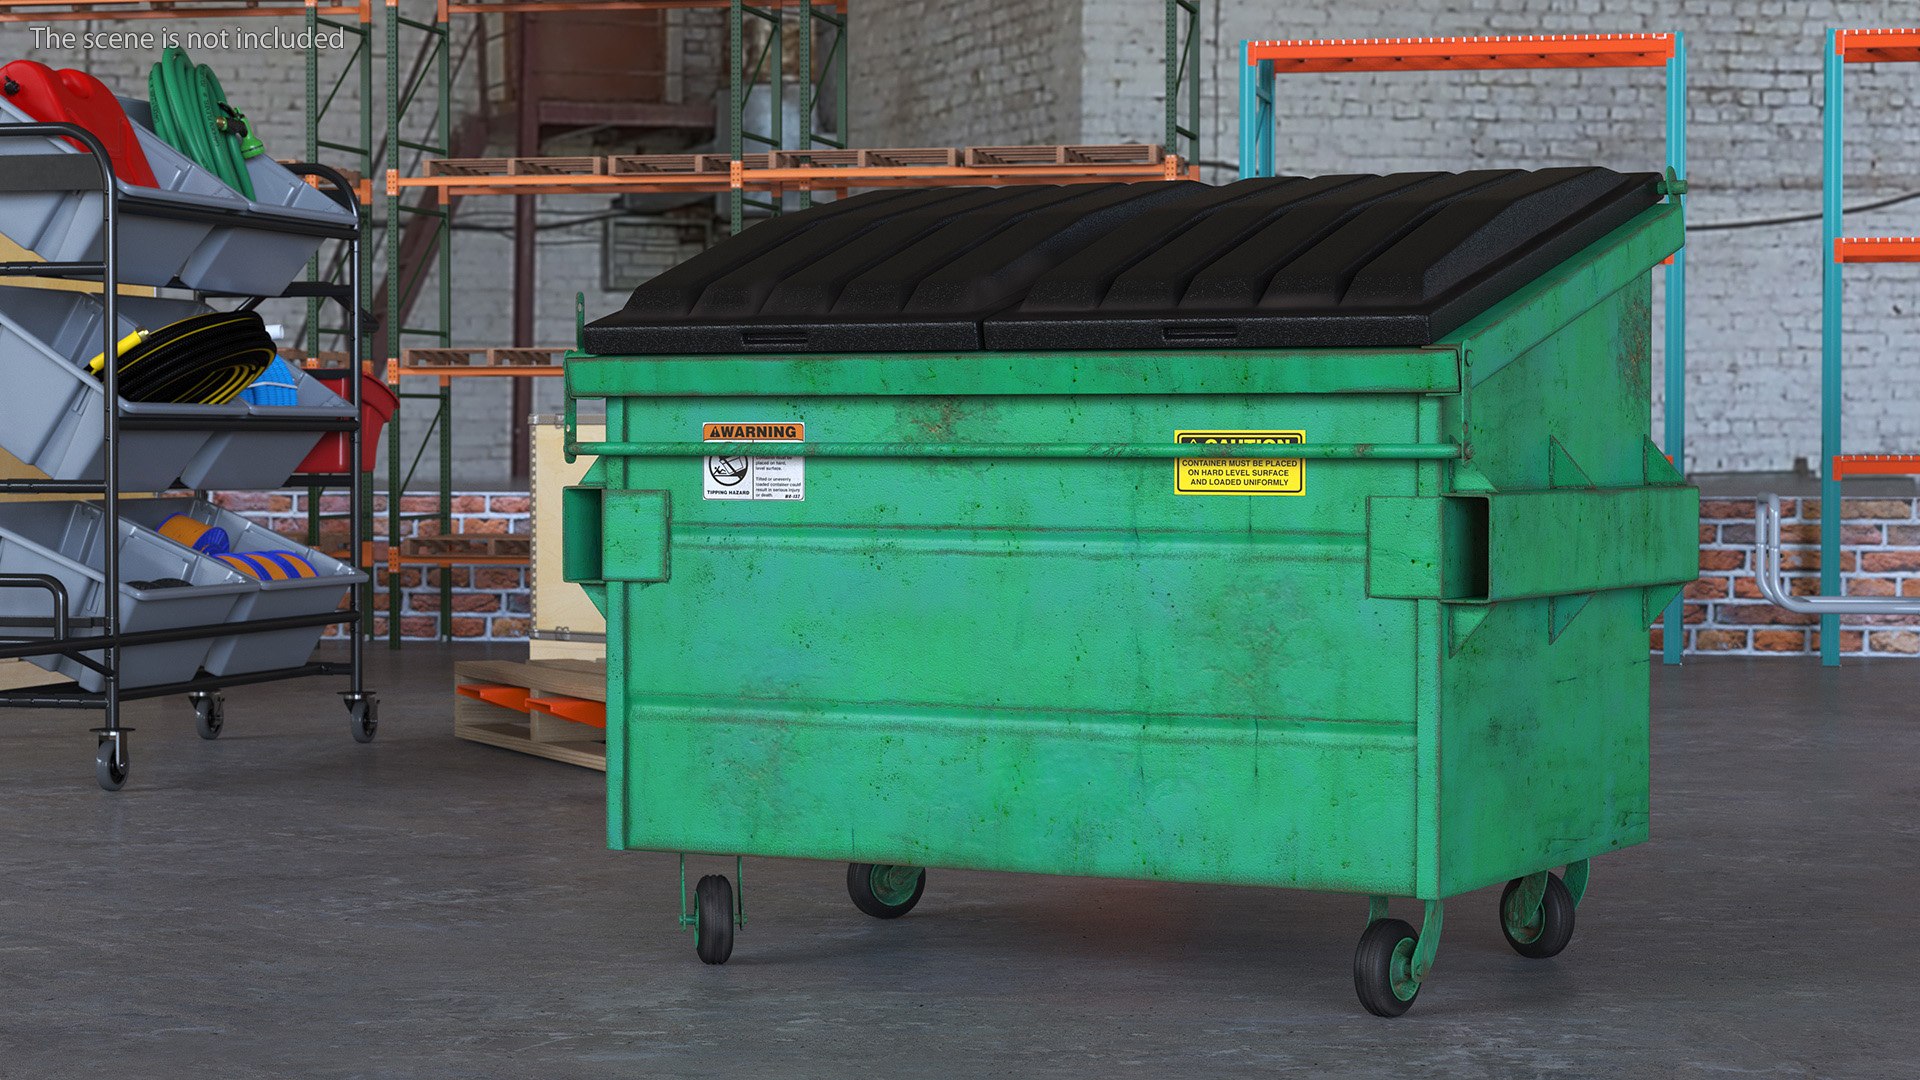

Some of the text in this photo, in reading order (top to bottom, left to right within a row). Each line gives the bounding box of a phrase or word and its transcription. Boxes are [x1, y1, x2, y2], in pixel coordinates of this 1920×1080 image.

[721, 426, 796, 438] WARNING
[1182, 459, 1298, 467] CONTAINER MUST BE PLACED
[1243, 478, 1289, 486] UNIFORMLY
